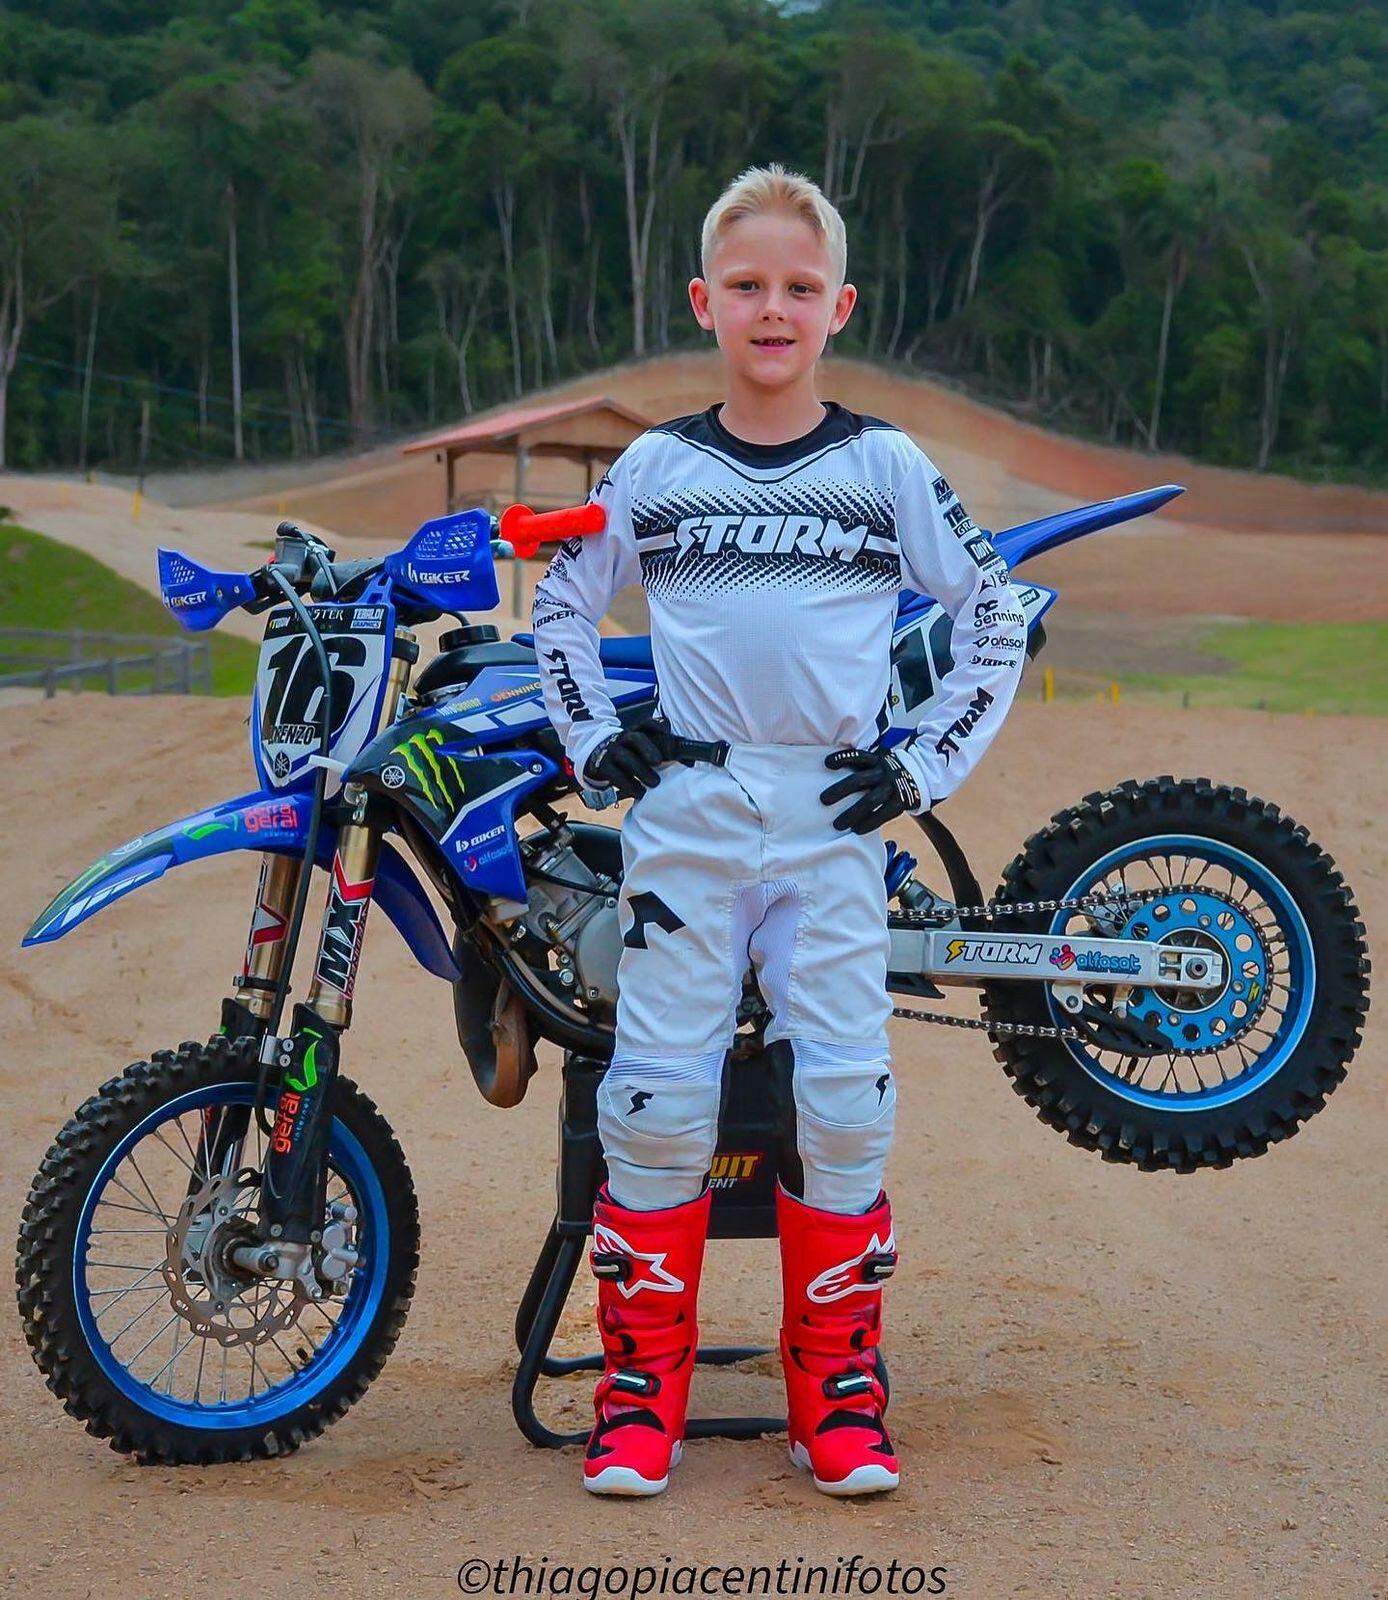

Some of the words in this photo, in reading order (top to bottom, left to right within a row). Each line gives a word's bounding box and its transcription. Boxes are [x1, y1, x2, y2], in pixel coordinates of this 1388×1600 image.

[672, 514, 868, 571] STORM
[420, 569, 471, 584] BIKER
[261, 634, 367, 742] 16
[542, 647, 595, 723] STORM
[316, 886, 366, 995] MX
[944, 939, 1043, 965] STORM
[1075, 951, 1142, 971] alfasat
